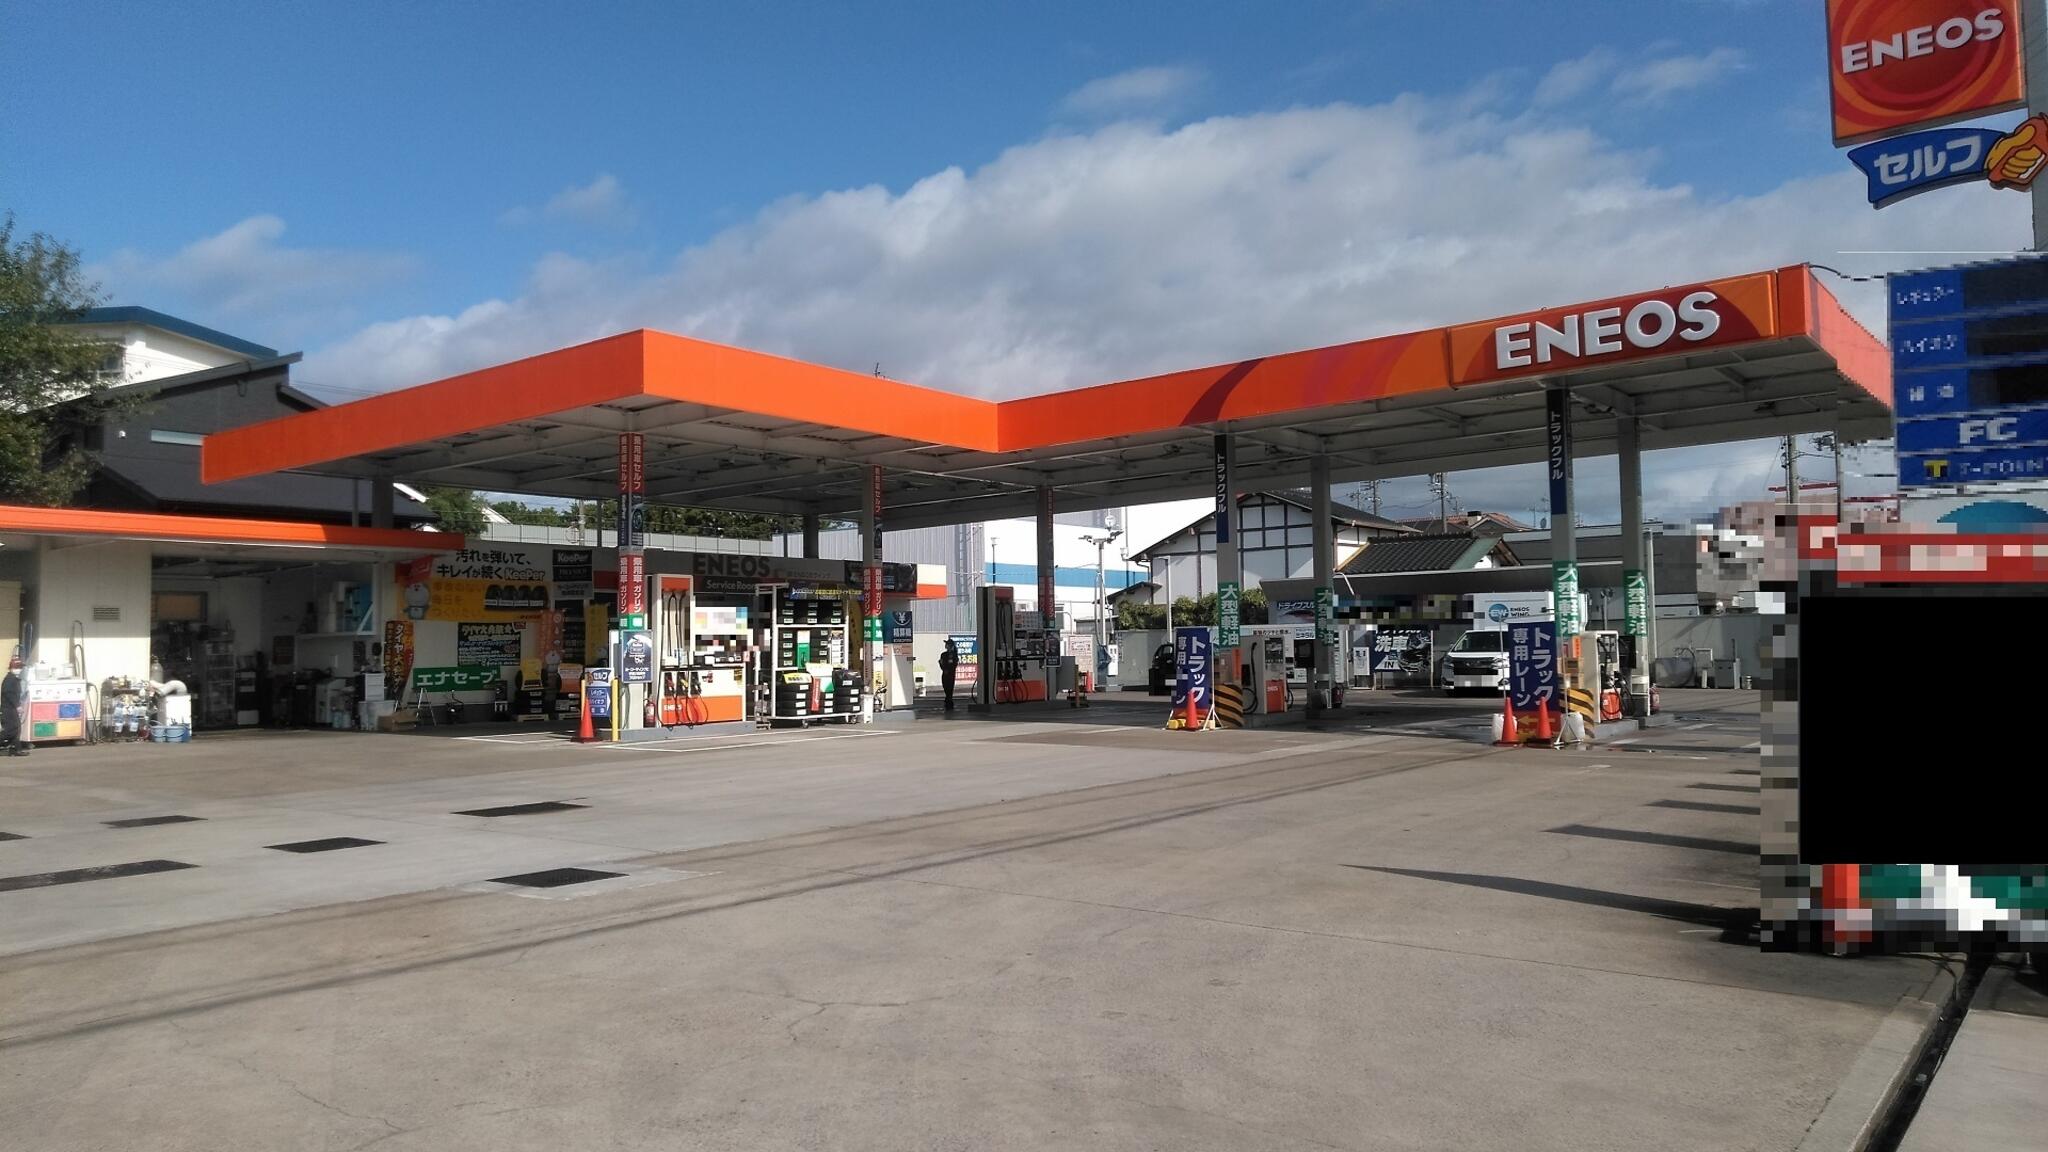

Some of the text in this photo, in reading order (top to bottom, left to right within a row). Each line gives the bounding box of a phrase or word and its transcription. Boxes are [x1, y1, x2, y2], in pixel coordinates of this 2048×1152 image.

[1841, 8, 2004, 73] ENEOS
[1874, 135, 1982, 185] セルフ
[1495, 291, 1721, 369] ENEOS
[1551, 411, 1563, 480] トラックフル
[1959, 417, 2018, 444] FC
[1216, 453, 1227, 513] トラックフル
[1960, 456, 2048, 476] T-POIN
[437, 565, 502, 579] キレイが続く
[504, 570, 545, 581] KeePer
[693, 555, 770, 577] ENEOS
[706, 580, 736, 591] Service
[1220, 584, 1239, 645] 大型軽油
[1317, 589, 1334, 645] 大型軽油
[1557, 564, 1579, 635] 大型軽油
[1628, 572, 1647, 634] 大型軽油
[1188, 636, 1205, 703] トラック
[1374, 635, 1409, 653] 洗車
[1513, 628, 1530, 707] 専用レーン
[1531, 627, 1554, 704] トラック
[417, 669, 497, 686] エナセーブ
